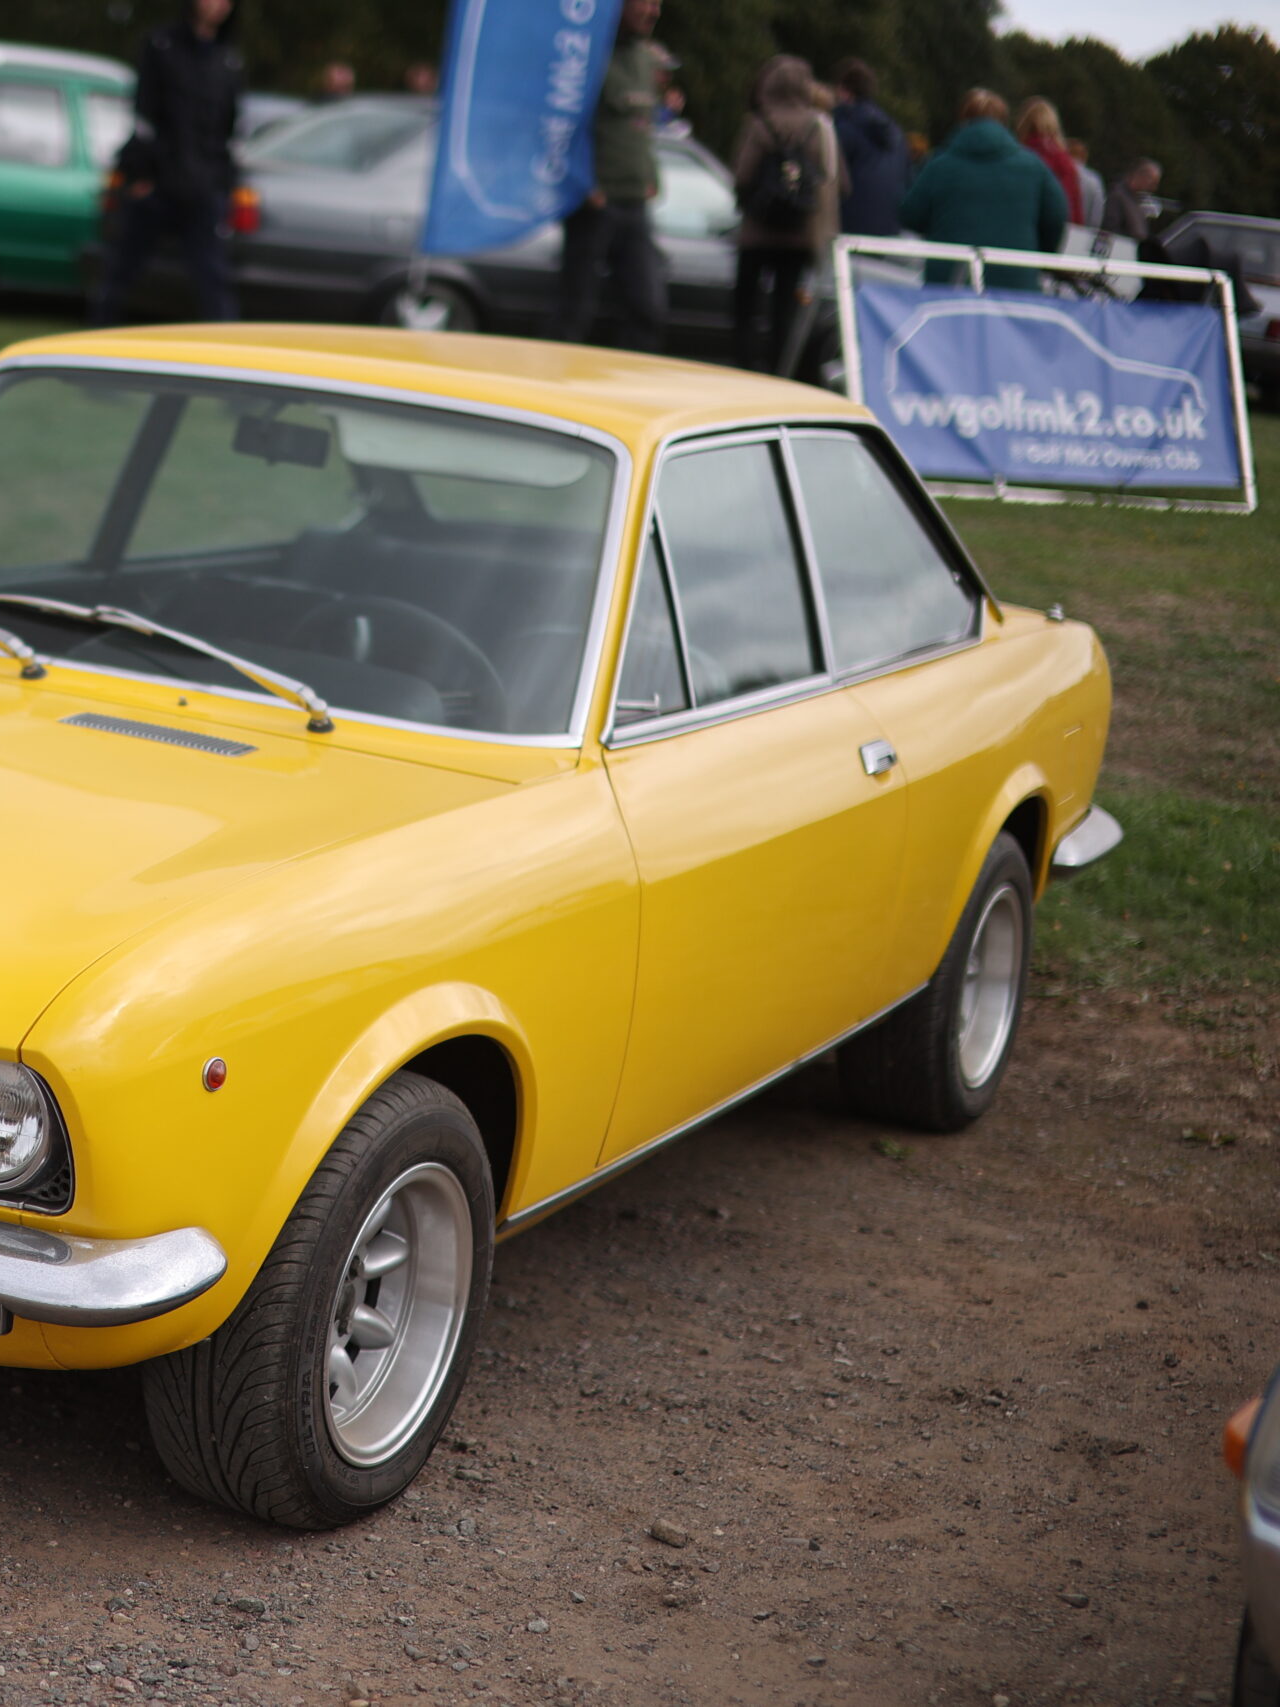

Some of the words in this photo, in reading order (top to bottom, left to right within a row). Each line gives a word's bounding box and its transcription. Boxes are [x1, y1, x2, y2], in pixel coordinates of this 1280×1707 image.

[546, 30, 590, 113] Mk2
[890, 384, 1206, 440] vwgolfmk2.co.uk
[301, 1368, 317, 1456] ULTRA
